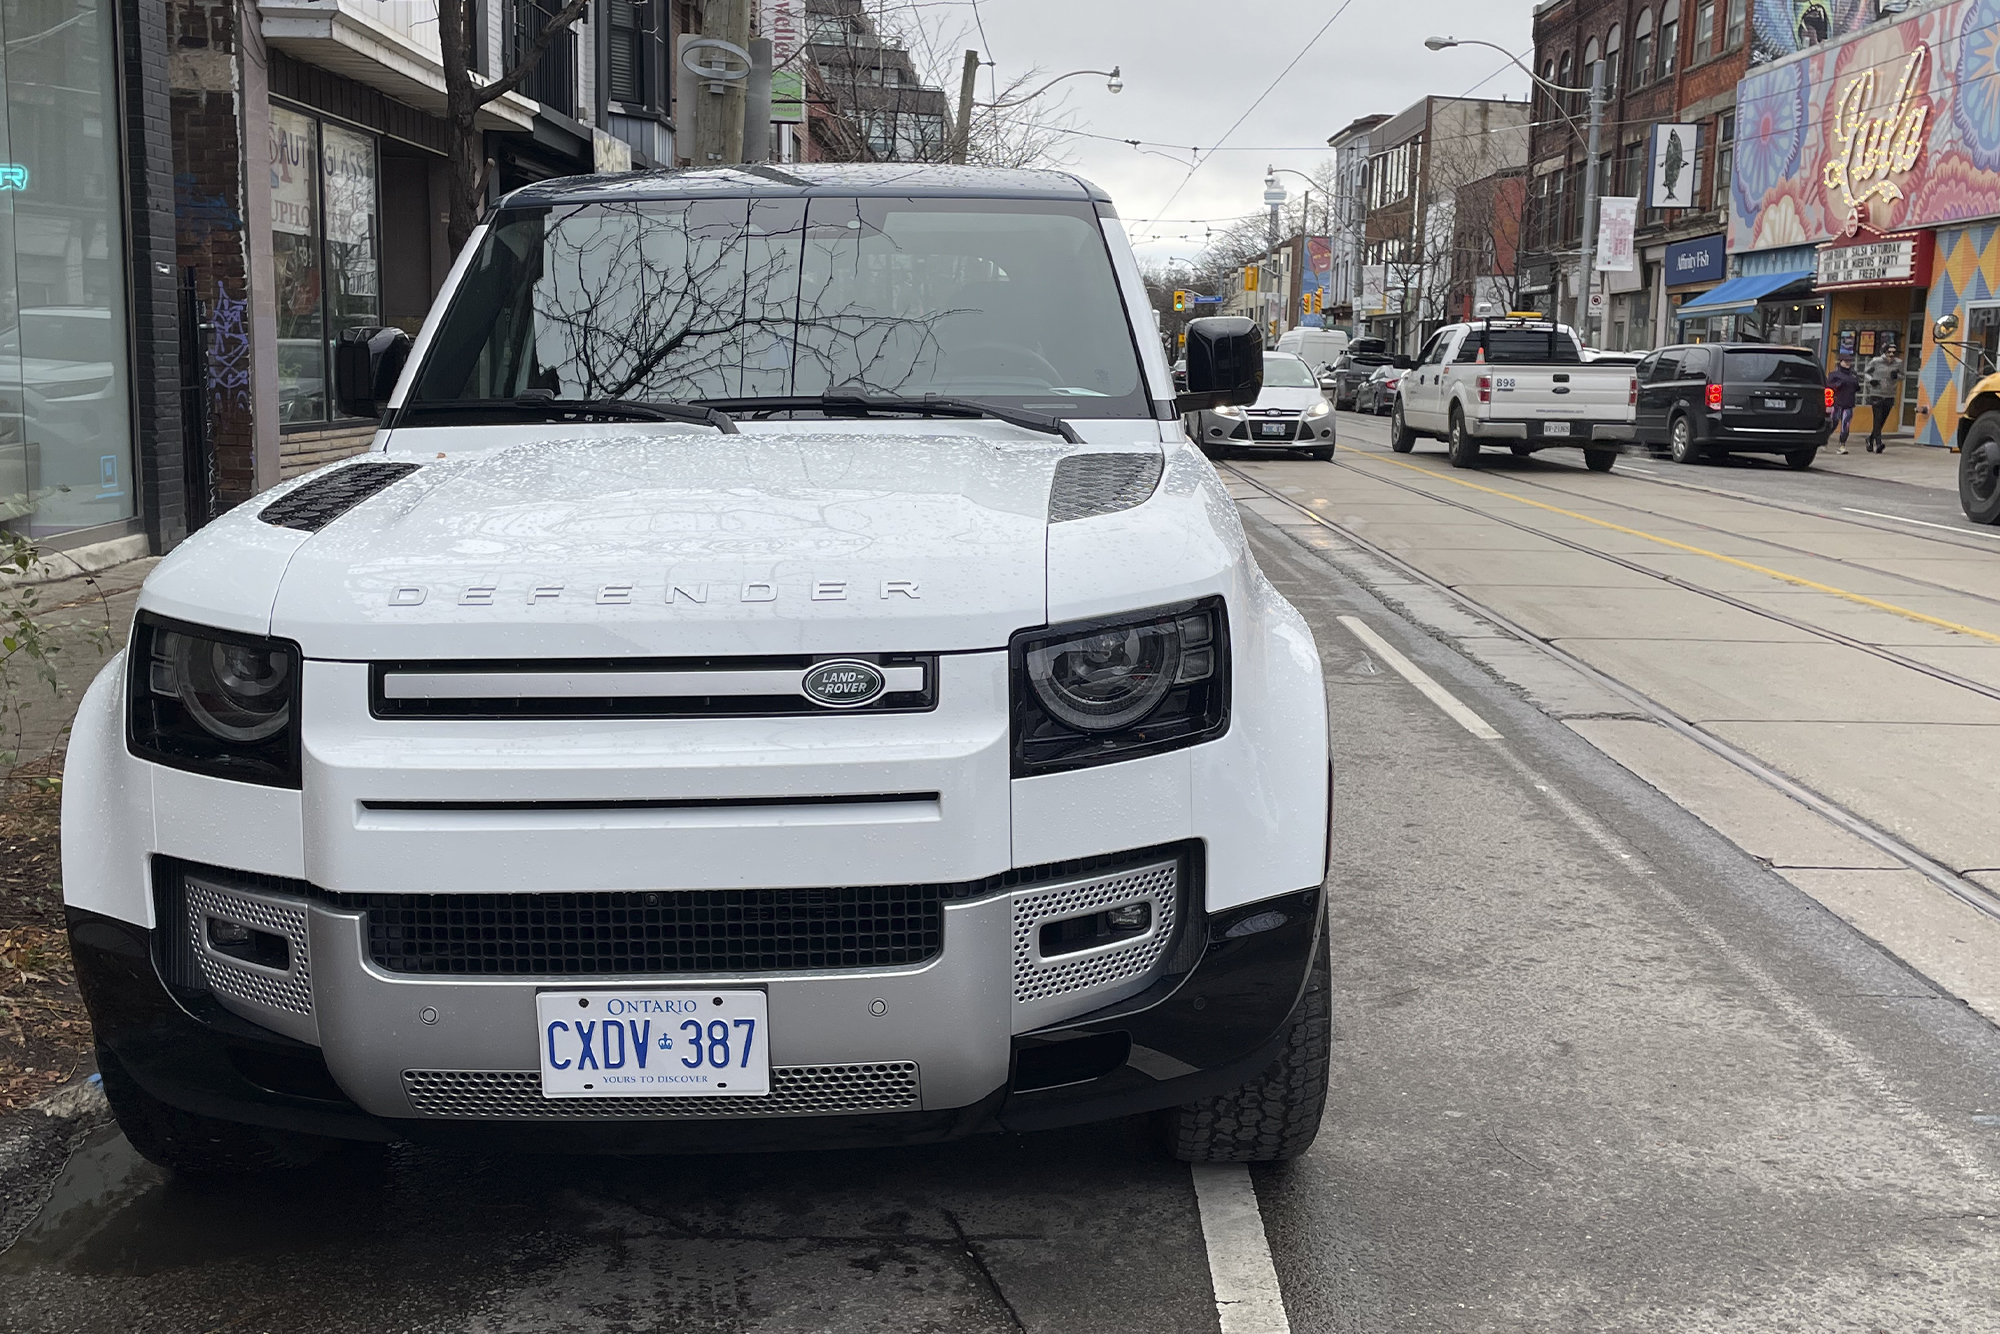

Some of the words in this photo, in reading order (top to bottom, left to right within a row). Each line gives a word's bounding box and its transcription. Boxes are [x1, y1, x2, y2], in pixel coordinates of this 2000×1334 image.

[1852, 246, 1868, 257] SALSA
[1870, 243, 1901, 256] SATURDAY
[1879, 255, 1899, 266] PARTY
[1859, 267, 1887, 279] FREEDOM
[1496, 378, 1516, 387] 898
[387, 579, 921, 607] DEFENDER
[607, 998, 697, 1016] ONTARIO
[547, 1019, 651, 1071] CXDV
[679, 1018, 756, 1070] 387
[602, 1075, 637, 1085] YOURS
[639, 1075, 655, 1084] TO
[657, 1074, 709, 1084] DISCOVER
